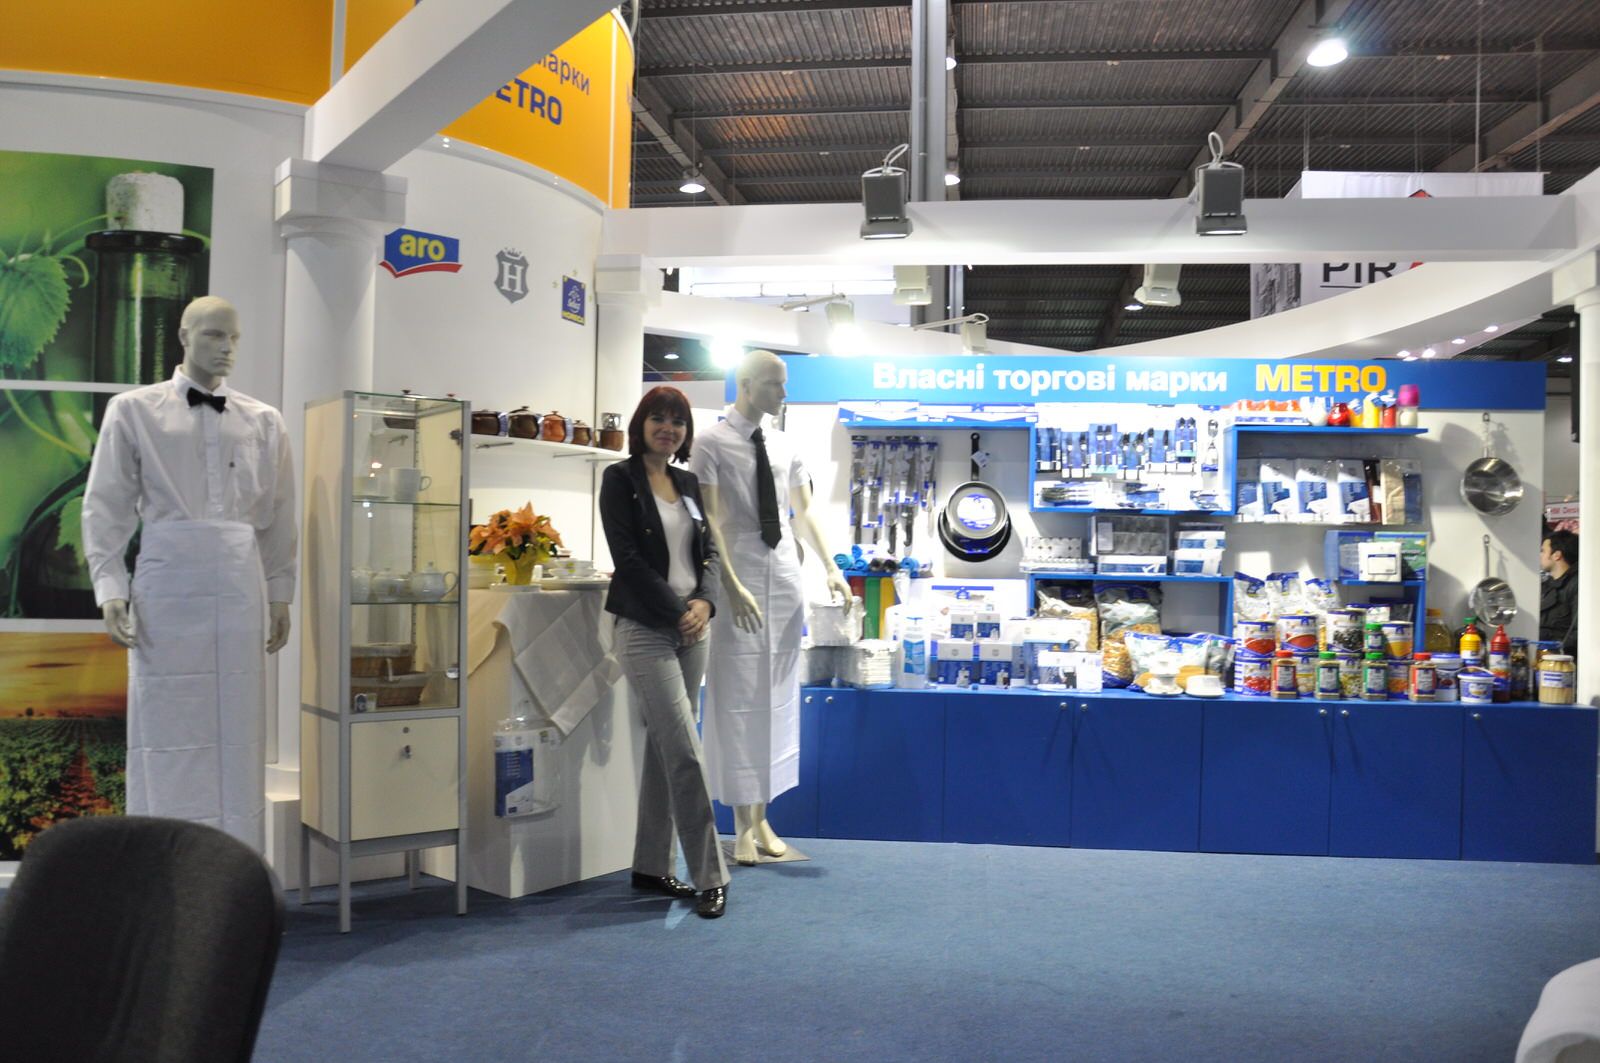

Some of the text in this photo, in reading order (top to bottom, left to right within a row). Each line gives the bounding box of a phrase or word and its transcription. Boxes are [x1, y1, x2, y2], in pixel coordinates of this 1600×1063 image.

[538, 53, 590, 96] арки
[496, 78, 562, 125] ETRO
[400, 234, 446, 261] aro
[499, 261, 525, 294] H
[873, 363, 1388, 398] Власні торгові марки METRO
